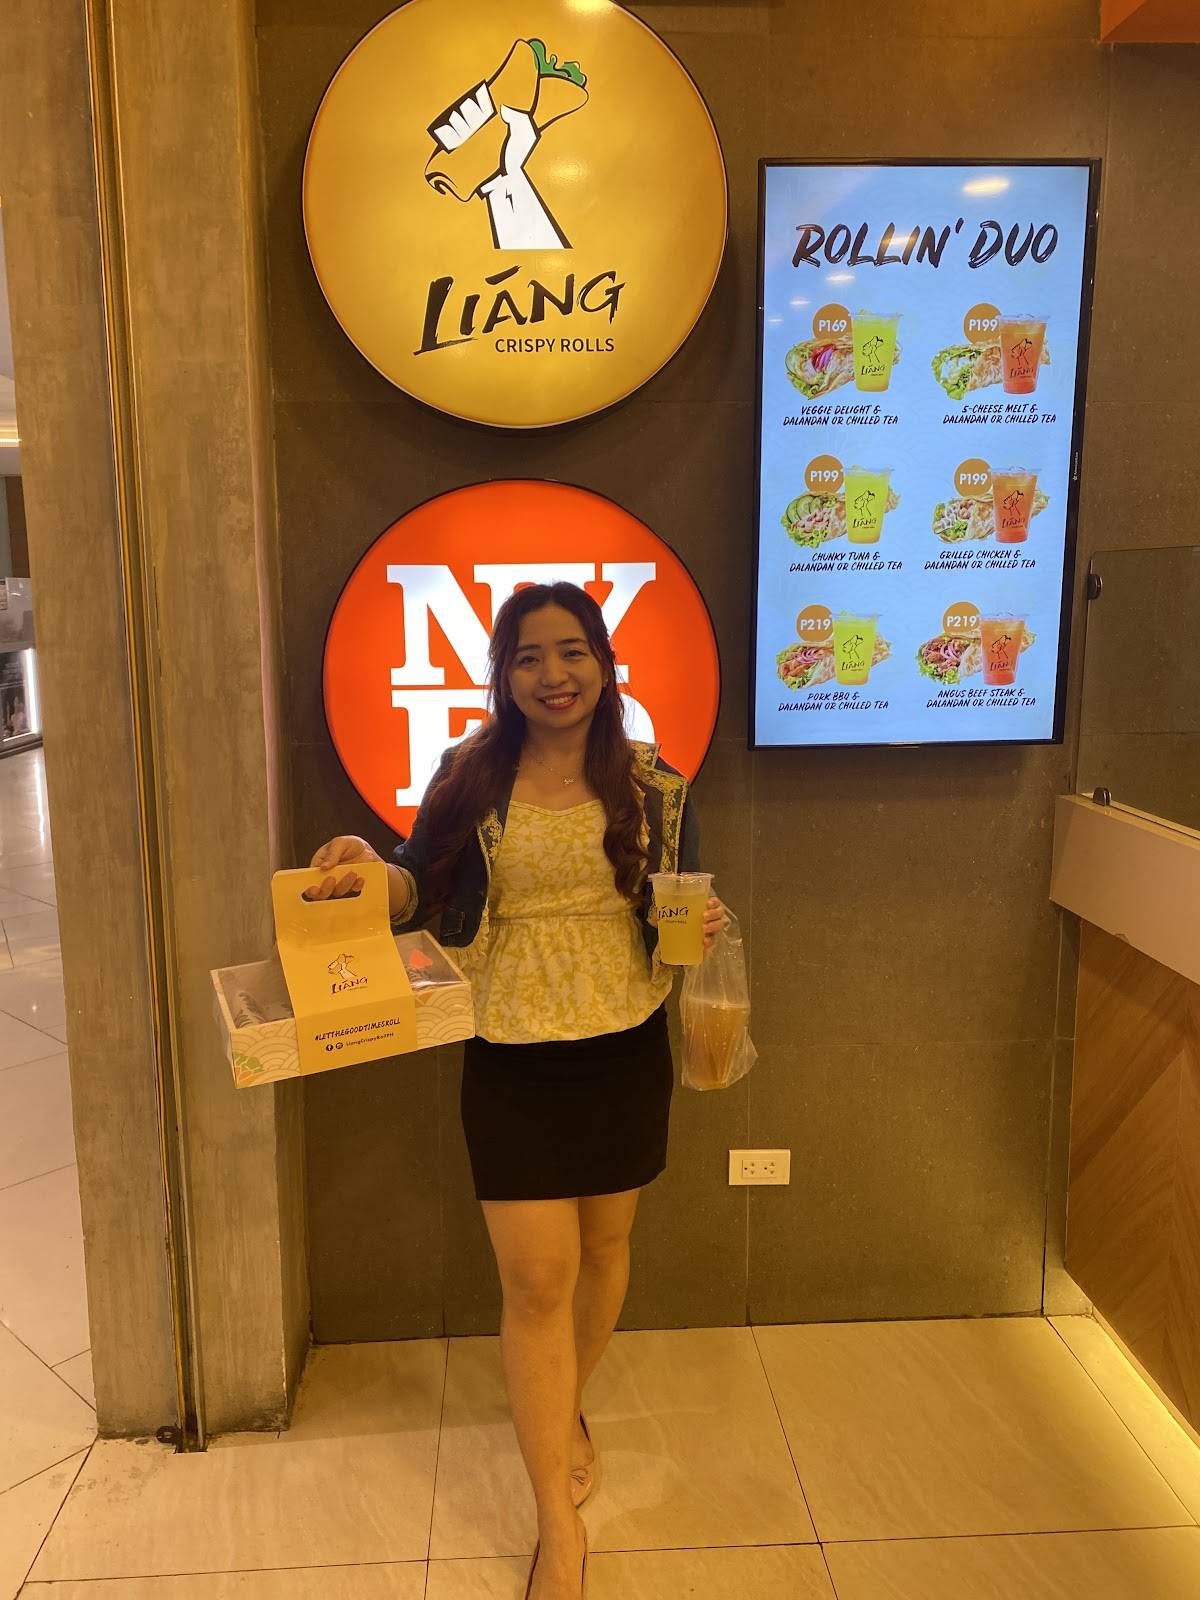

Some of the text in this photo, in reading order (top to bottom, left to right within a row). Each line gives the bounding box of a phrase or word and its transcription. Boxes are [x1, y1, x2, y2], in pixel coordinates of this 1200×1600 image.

[791, 217, 1059, 269] ROLLIN' DUO
[818, 319, 847, 332] P169
[968, 318, 998, 332] P199
[495, 338, 615, 353] CRISPY ROLLS
[801, 405, 882, 415] VEGGIE DELIGHT &
[961, 404, 1038, 413] 5-CHEESE MELT &
[783, 415, 899, 426] DALANDAN OR CHILLED TEA
[942, 413, 1056, 424] DALANDAN OR CHILLED TEA
[810, 470, 839, 482] P199
[959, 473, 988, 485] P199
[811, 551, 881, 561] CHUNKY TUNA &
[939, 549, 1022, 559] GRILLED CHICKEN &
[789, 561, 903, 572] DALANDAN OR CHILLED TEA
[924, 559, 1036, 570] DALANDAN OR CHILLED TEA
[800, 618, 831, 631] P219
[946, 615, 977, 627] P219
[807, 691, 860, 701] PORK BBQ &
[937, 688, 1026, 698] ANGUS BEEF STEAK &
[778, 700, 889, 711] DALANDAN OR CHILLED TEA
[926, 697, 1036, 708] DALANDAN OR CHILLED TEA
[314, 1017, 401, 1041] #LETTHEGOODTIMESROLL
